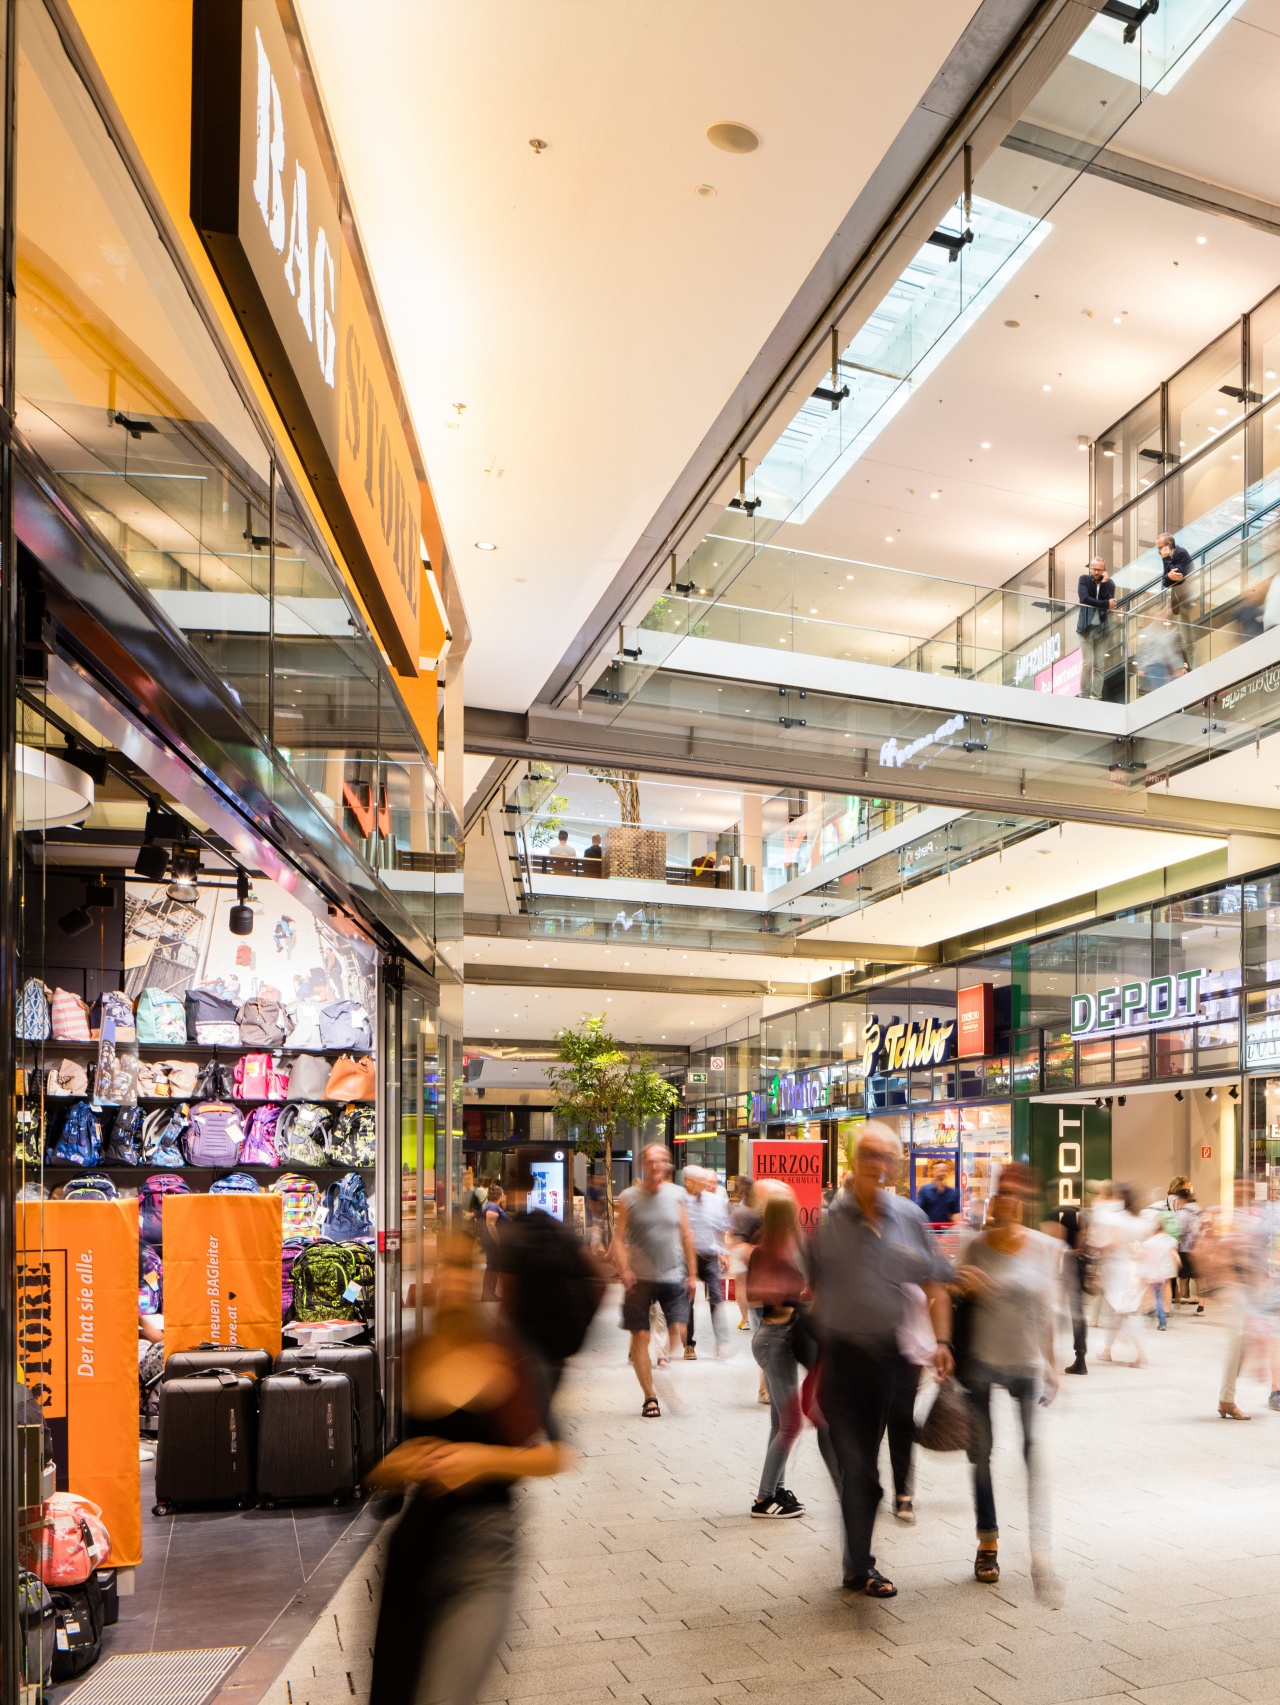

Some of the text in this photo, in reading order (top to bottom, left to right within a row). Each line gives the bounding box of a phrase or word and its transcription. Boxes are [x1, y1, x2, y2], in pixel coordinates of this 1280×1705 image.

[252, 26, 419, 620] BAG STORE
[1071, 968, 1206, 1034] DEPOT
[885, 1018, 955, 1070] Tchibo
[756, 1154, 819, 1174] HERZOG
[75, 1249, 95, 1377] Der hat sie alle.
[206, 1235, 221, 1339] neuen BAGleiter
